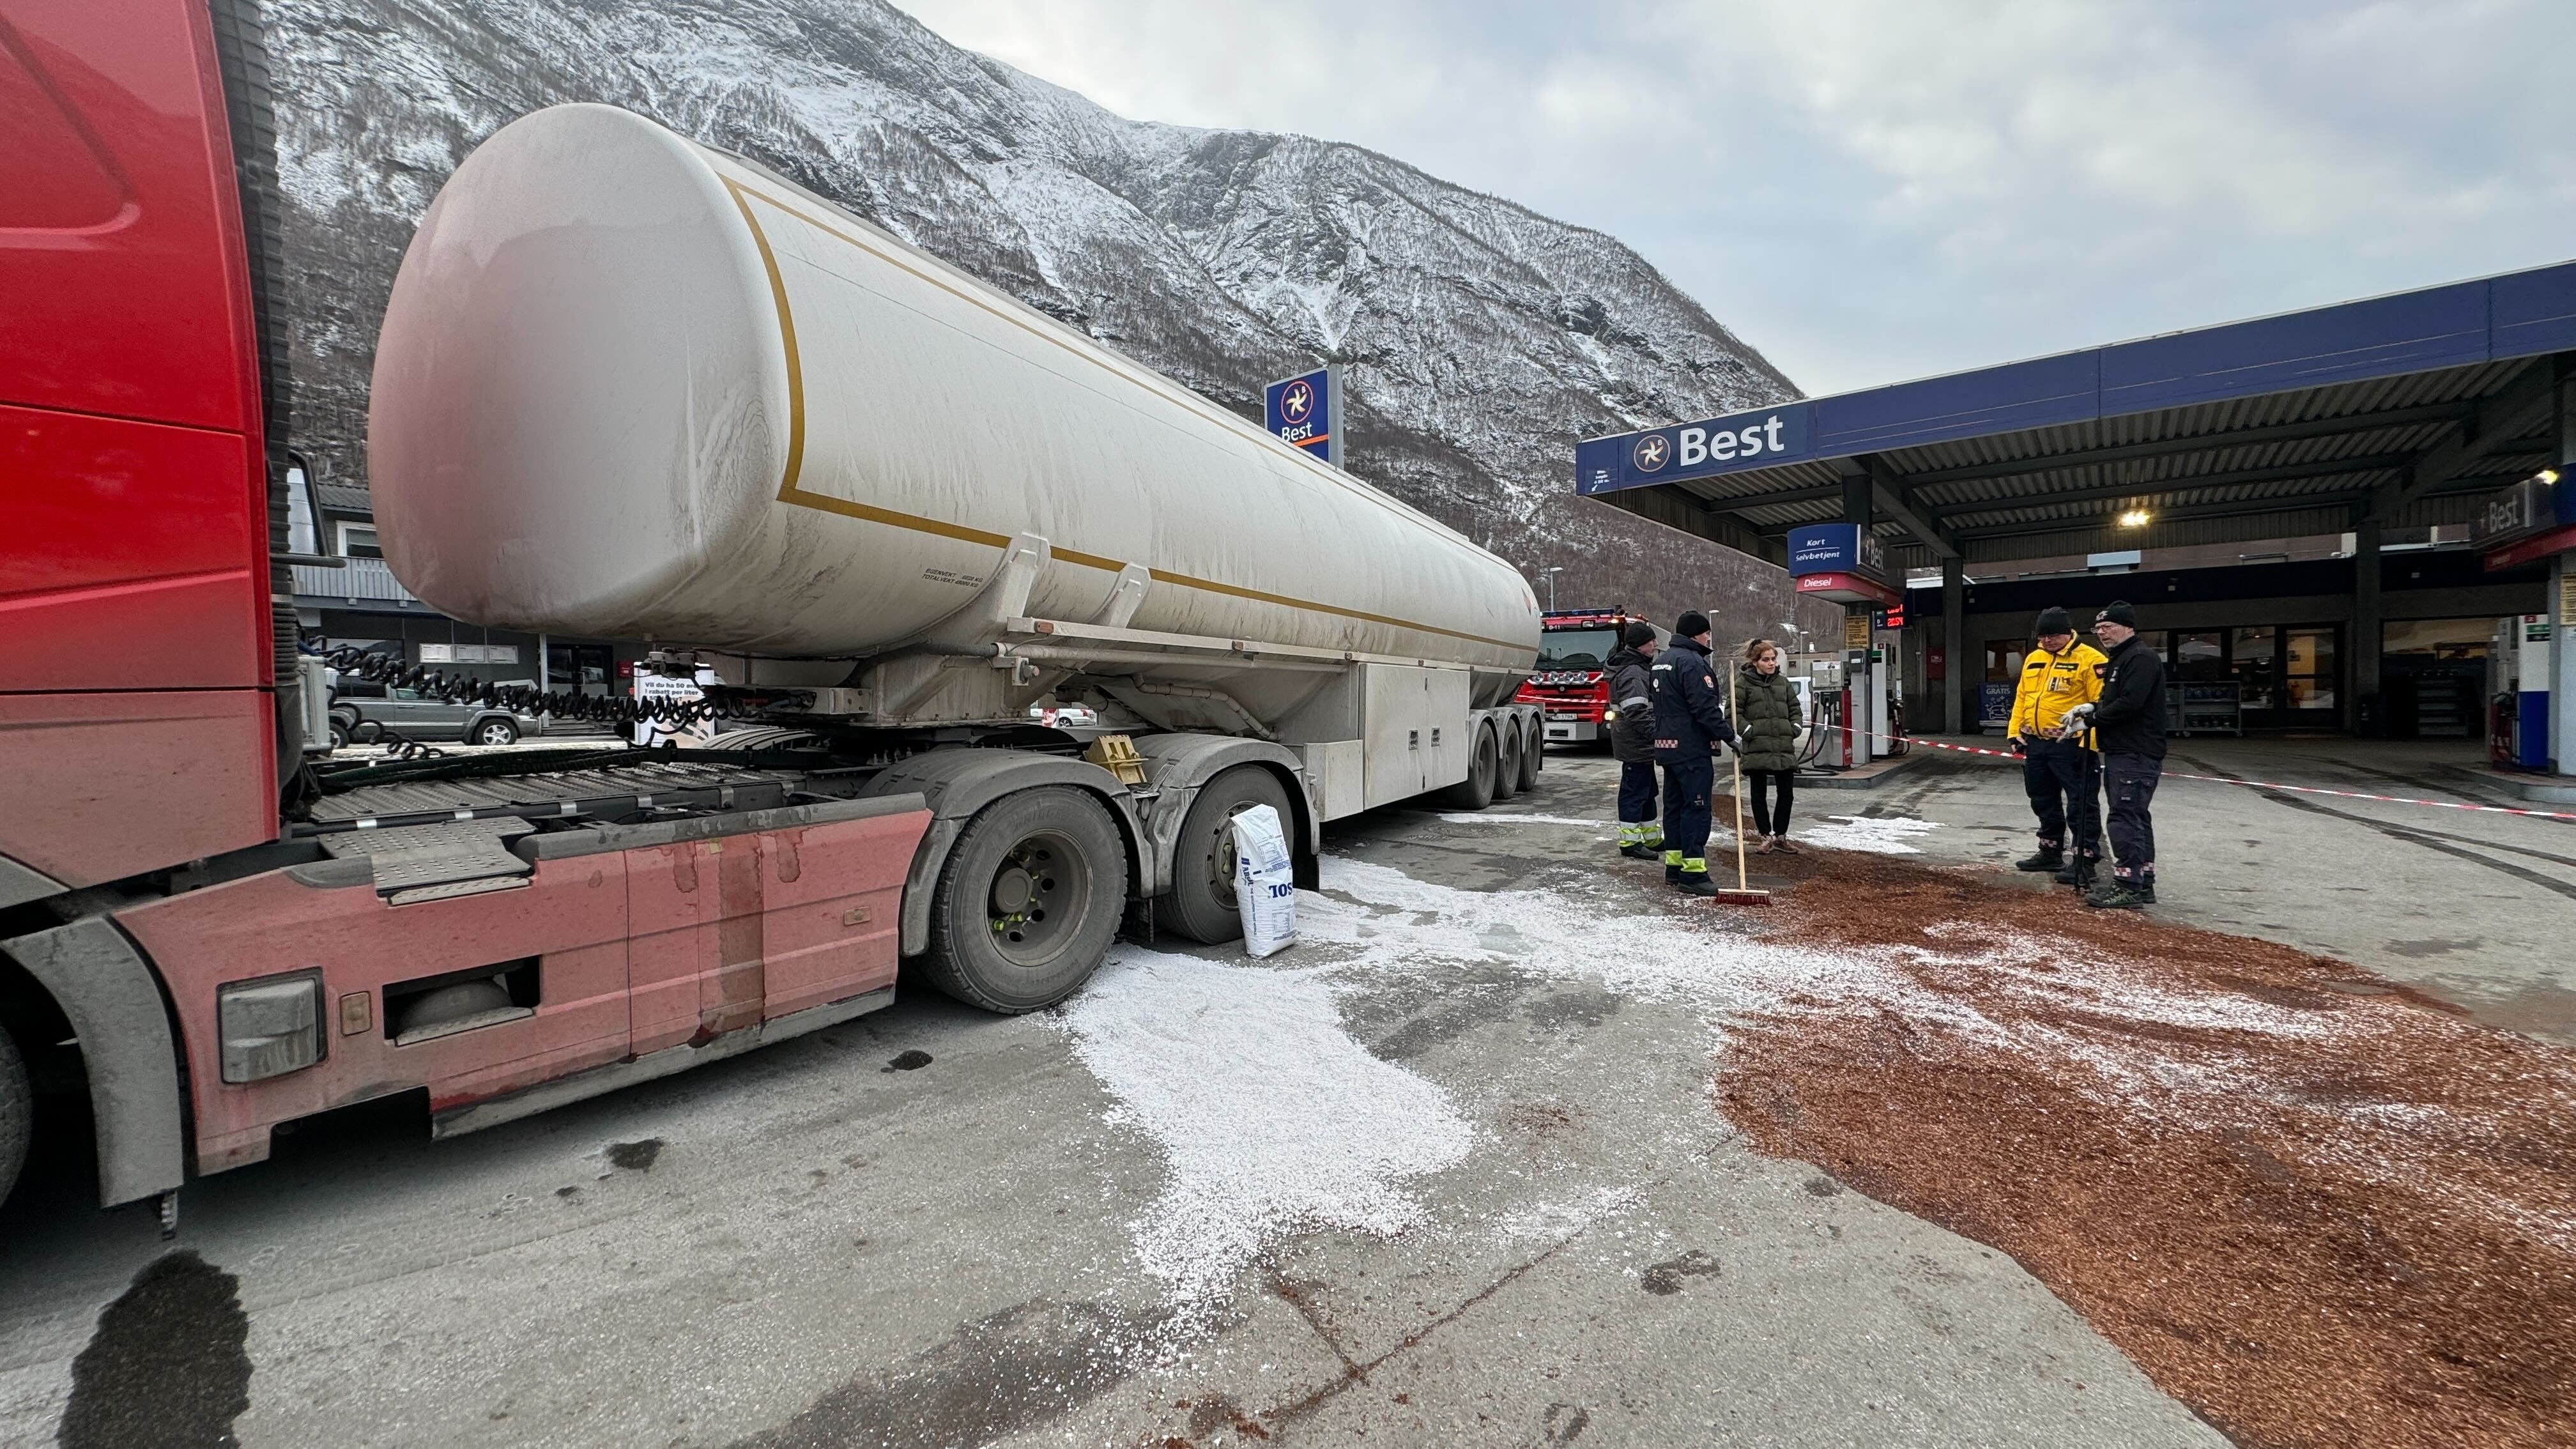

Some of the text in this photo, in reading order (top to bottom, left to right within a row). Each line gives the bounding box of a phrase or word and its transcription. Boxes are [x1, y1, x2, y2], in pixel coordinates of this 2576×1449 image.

[1282, 422, 1312, 442] Best
[1680, 415, 1784, 466] Best
[2489, 494, 2517, 533] Best
[1795, 551, 1840, 562] Selvbetjent
[1871, 538, 1884, 571] Best
[1804, 577, 1832, 588] Diesel
